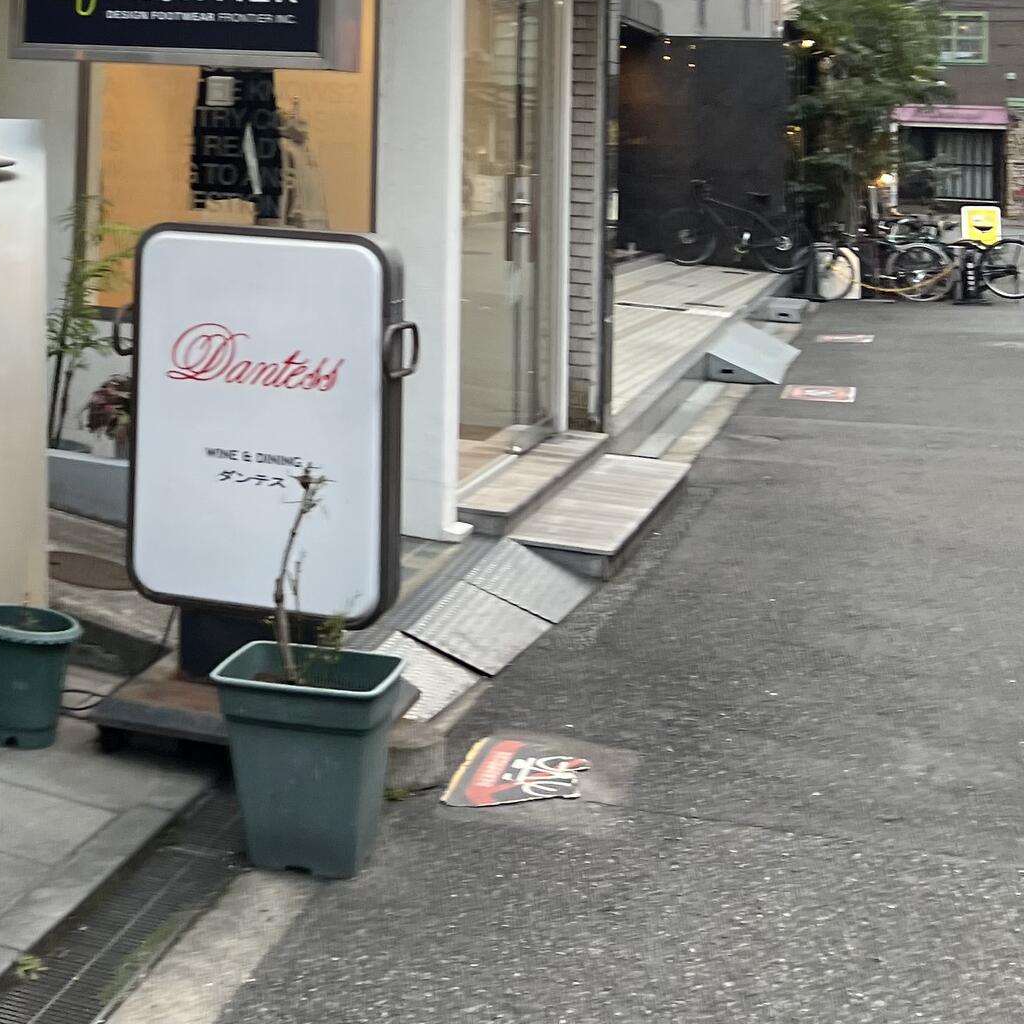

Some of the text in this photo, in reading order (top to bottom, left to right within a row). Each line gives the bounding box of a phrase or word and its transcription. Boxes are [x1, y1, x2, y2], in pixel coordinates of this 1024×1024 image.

[105, 9, 149, 21] DESIGN
[150, 10, 216, 22] FOOTWEAR
[204, 447, 237, 462] WINE
[256, 452, 302, 468] DINING
[218, 470, 287, 488] ダンテス
